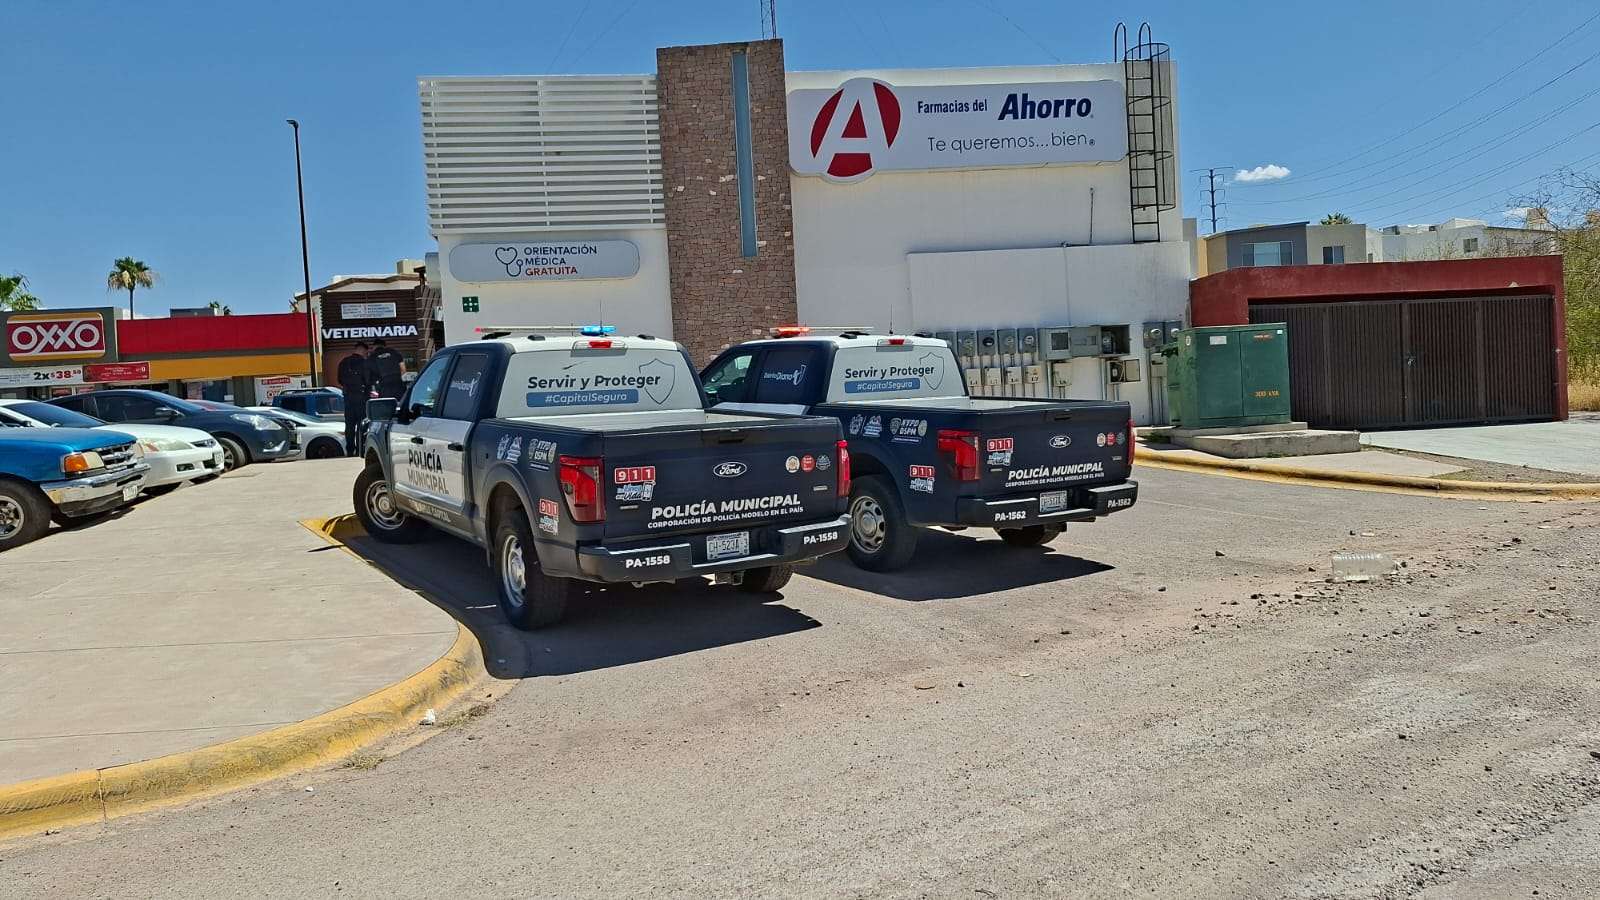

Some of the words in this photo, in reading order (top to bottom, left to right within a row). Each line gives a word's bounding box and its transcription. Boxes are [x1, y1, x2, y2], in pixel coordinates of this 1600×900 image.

[917, 100, 969, 114] Farmacias
[971, 98, 988, 112] del
[998, 93, 1092, 121] Ahorro
[927, 137, 947, 152] Te
[524, 244, 597, 255] ORIENTACIÓN
[525, 257, 567, 266] MÉDICA
[525, 266, 578, 276] GRATUITA
[11, 320, 100, 355] OXXO
[322, 325, 418, 340] VETERINARIA
[844, 366, 878, 379] Servir
[880, 368, 887, 379] y
[889, 366, 935, 377] Proteger
[527, 374, 577, 389] Servir
[580, 377, 590, 390] y
[594, 374, 661, 389] Proteger
[857, 380, 912, 391] #CapitalSegura
[545, 392, 628, 405] #CapitalSegura
[988, 439, 1012, 450] 911
[408, 448, 444, 474] POLICÍA
[617, 467, 652, 482] 911
[911, 466, 933, 476] 911
[1008, 465, 1049, 481] POLICÍA
[1051, 462, 1104, 476] MUNICIPAL
[407, 468, 450, 495] MUNICIPAL
[1005, 479, 1038, 488] CORPORACIÓN
[1046, 476, 1063, 484] POLICÍA
[540, 500, 557, 515] 911
[651, 500, 717, 520] POLICÍA
[720, 494, 801, 513] MUNICIPAL
[647, 517, 701, 529] CORPORACIÓN
[713, 512, 740, 522] POLICÍA
[741, 511, 769, 519] MODELO
[789, 506, 804, 514] PAÍS
[994, 510, 1027, 522] PA-1562
[803, 531, 839, 545] PA-1558
[625, 555, 671, 569] PA-1558
